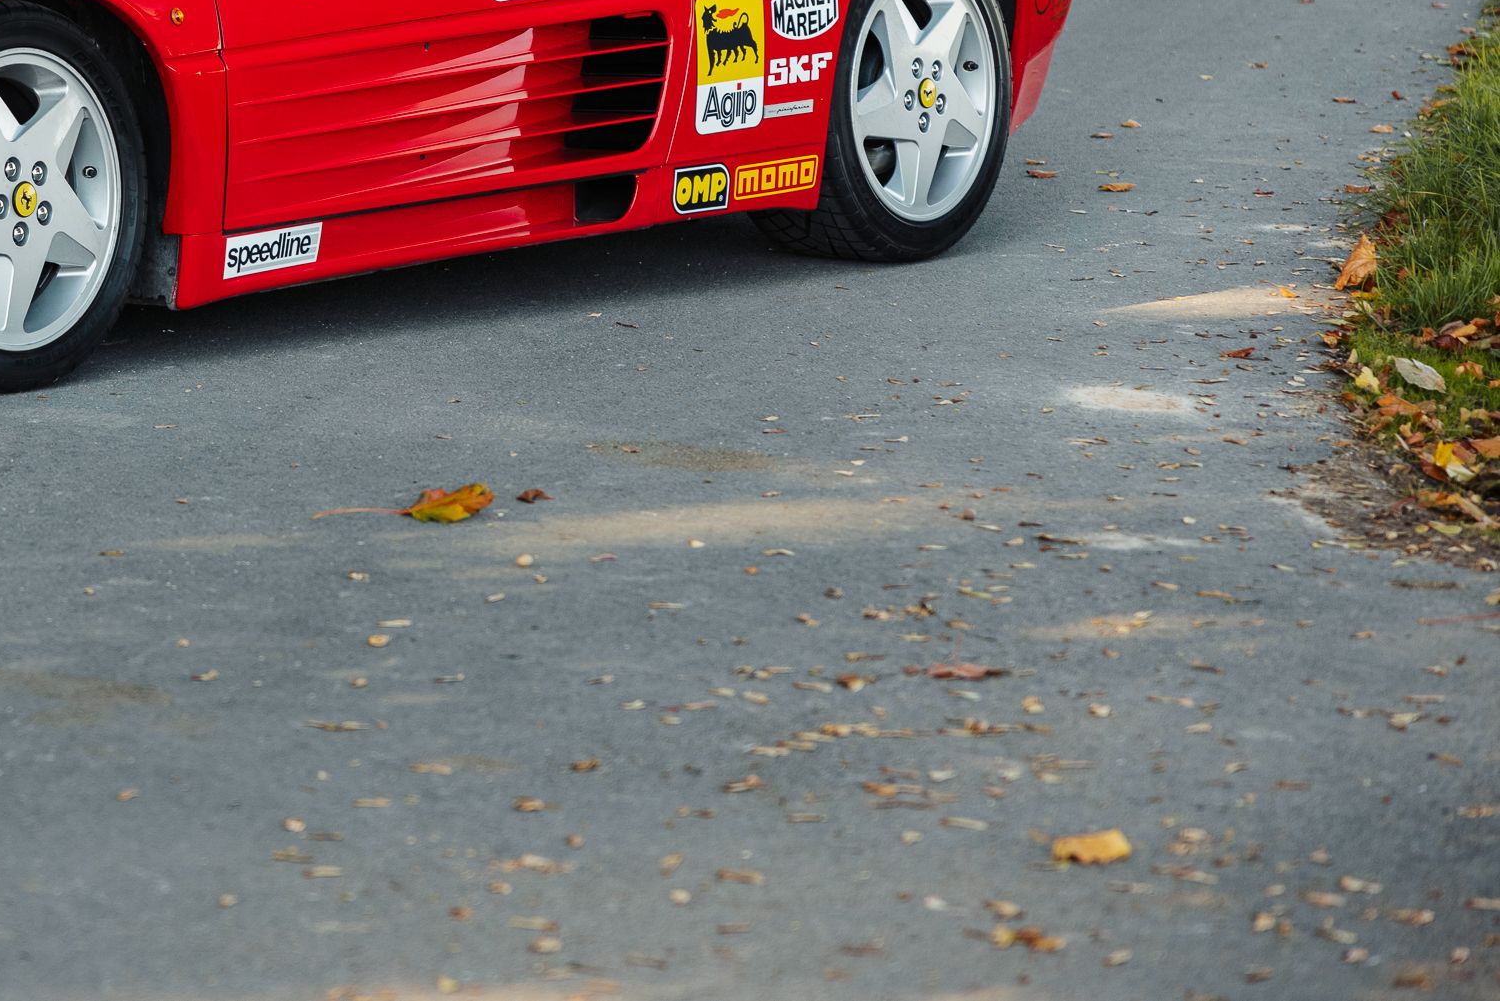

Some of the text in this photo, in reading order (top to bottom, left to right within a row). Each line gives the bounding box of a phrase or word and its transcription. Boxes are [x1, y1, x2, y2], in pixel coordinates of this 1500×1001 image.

[773, 4, 838, 37] MARELLI
[767, 51, 834, 88] SKF
[701, 82, 757, 128] Agip
[676, 171, 727, 206] OMP
[227, 231, 312, 273] speedline
